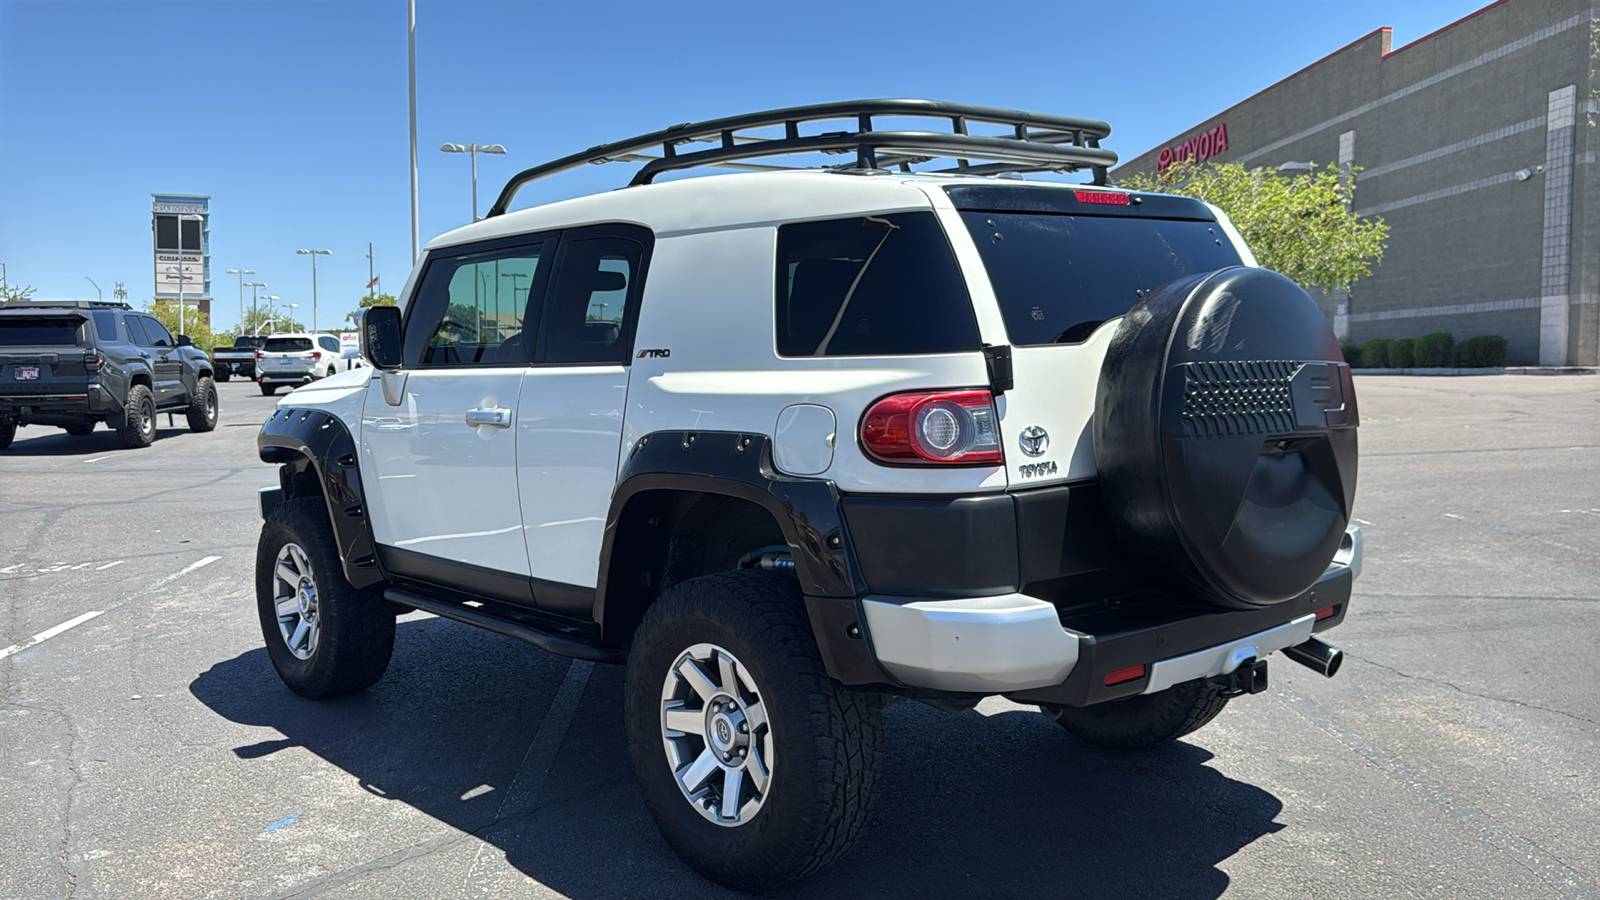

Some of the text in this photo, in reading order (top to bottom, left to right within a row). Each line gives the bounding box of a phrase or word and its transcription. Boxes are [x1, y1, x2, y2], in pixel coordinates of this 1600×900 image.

[1174, 123, 1229, 163] TOYOTA
[647, 348, 671, 358] TRD
[1019, 460, 1058, 478] TOYOTA
